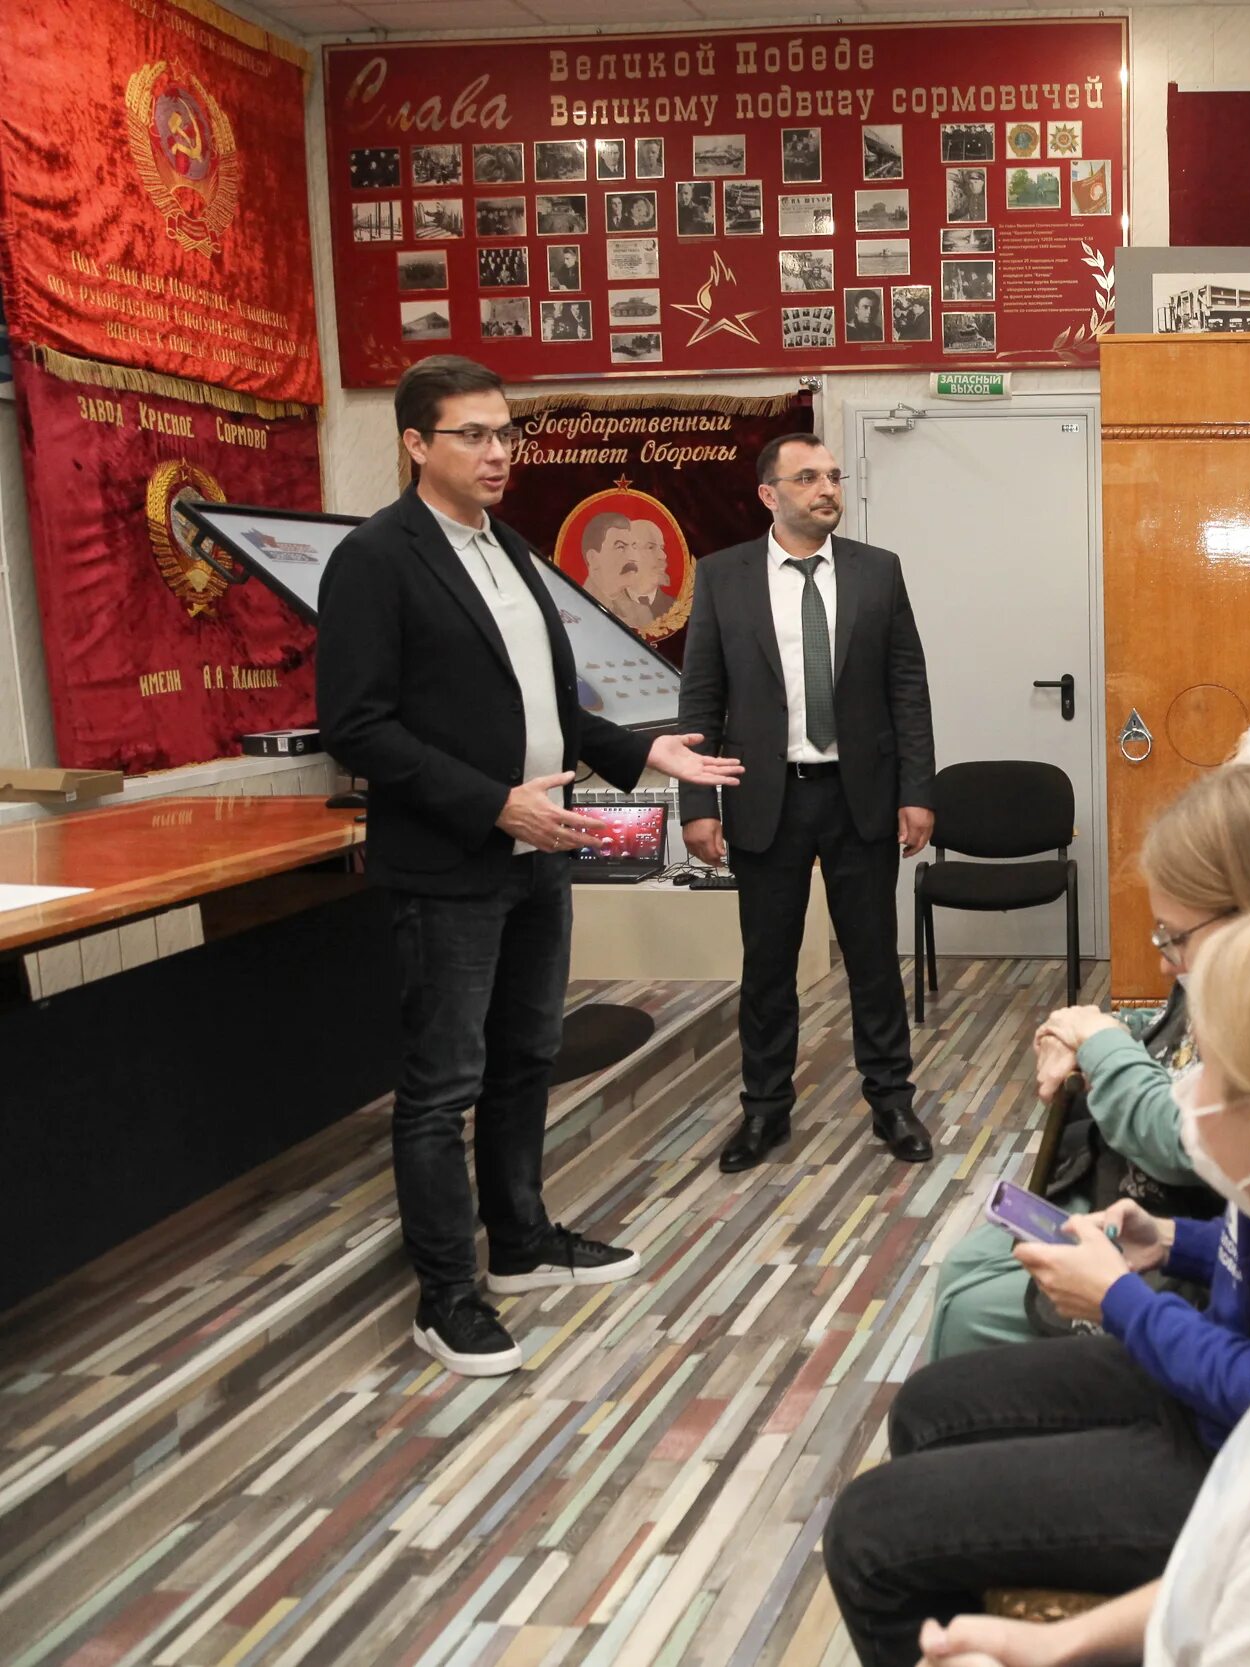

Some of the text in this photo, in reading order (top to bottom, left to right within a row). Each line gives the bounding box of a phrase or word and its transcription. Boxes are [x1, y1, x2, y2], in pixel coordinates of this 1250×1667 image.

[550, 39, 874, 81] Великой Победе
[346, 57, 512, 131] Слава
[550, 75, 1103, 126] Великому подвигу сормовичей
[940, 375, 1001, 384] ЗАПАСНЫЙ
[951, 384, 990, 394] ВЫХОД
[77, 395, 124, 427] ЗАВОД
[525, 410, 732, 441] Государственный
[510, 438, 737, 469] Комитет Обороны
[139, 669, 182, 697] ИМЕНИ
